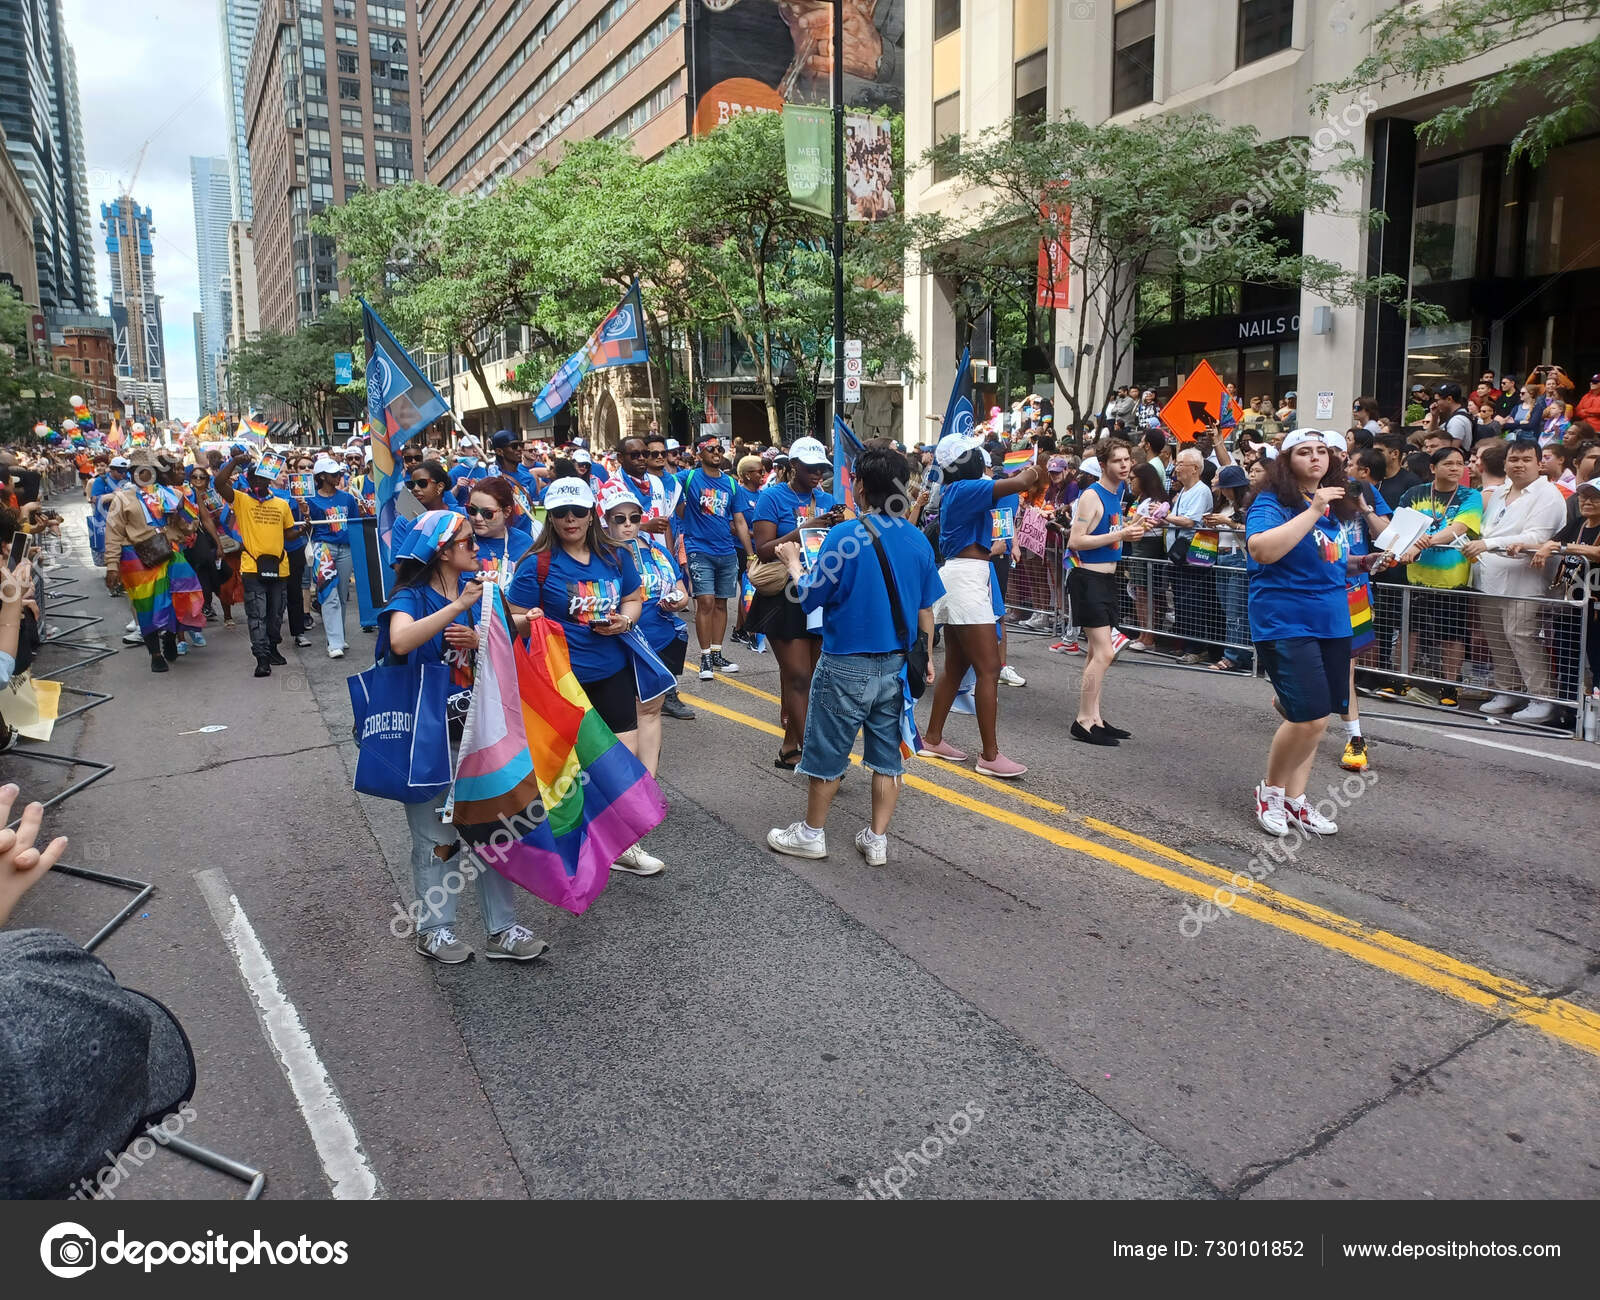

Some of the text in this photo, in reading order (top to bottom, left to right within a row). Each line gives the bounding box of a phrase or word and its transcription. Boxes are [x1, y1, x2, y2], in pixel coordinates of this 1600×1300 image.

[1239, 317, 1286, 338] NAILS
[700, 494, 729, 508] PRIDE
[379, 732, 402, 740] COLLEGE
